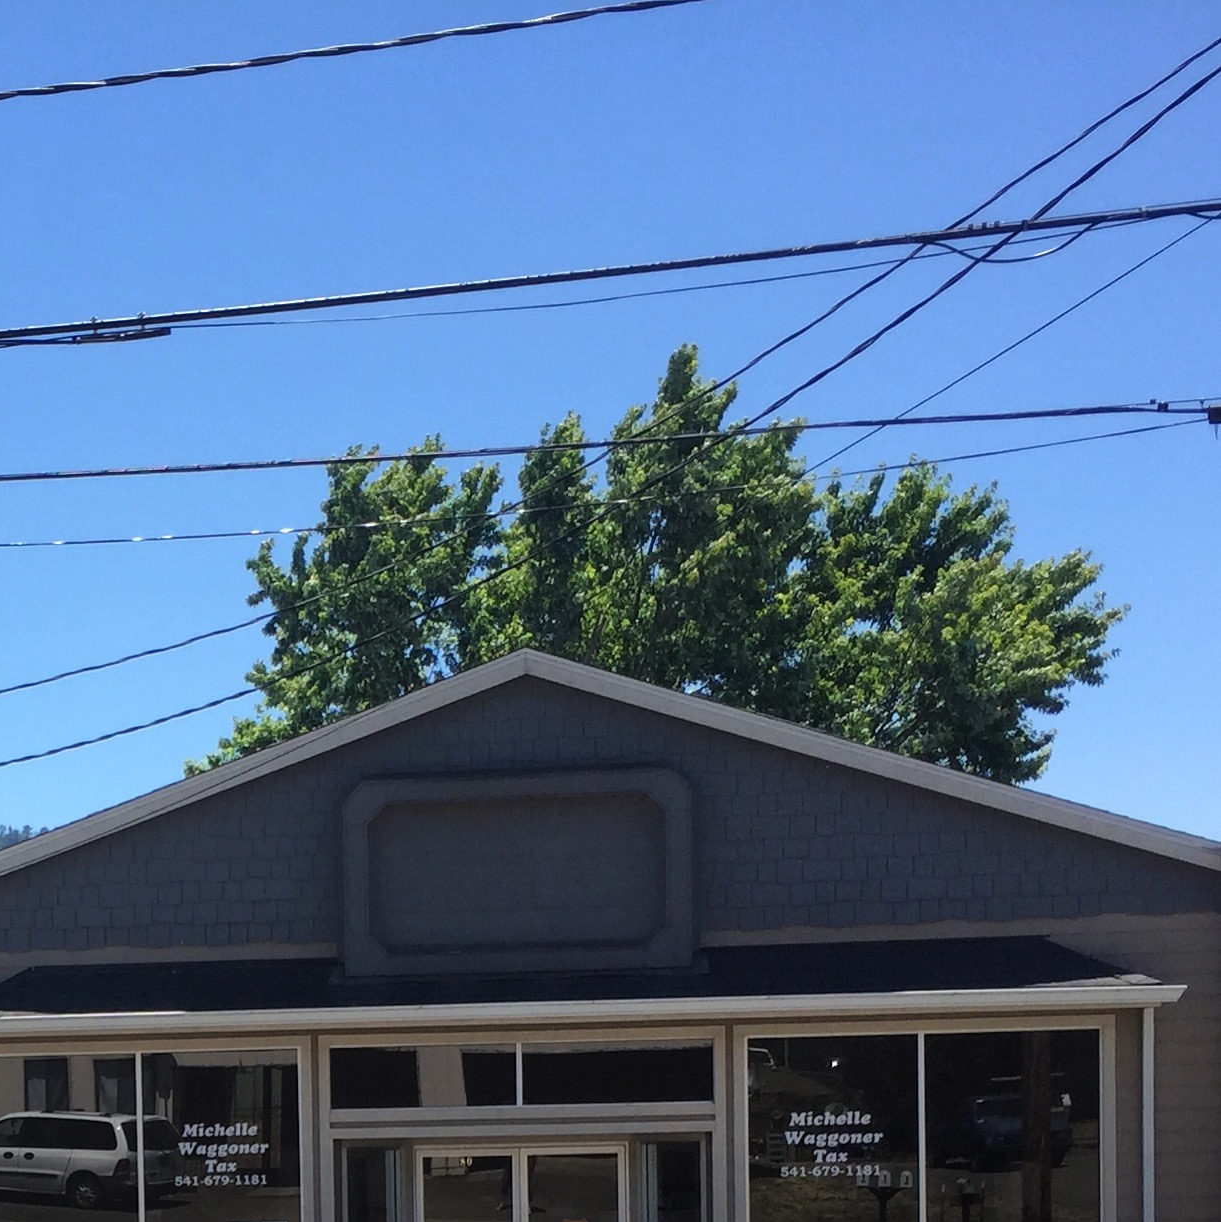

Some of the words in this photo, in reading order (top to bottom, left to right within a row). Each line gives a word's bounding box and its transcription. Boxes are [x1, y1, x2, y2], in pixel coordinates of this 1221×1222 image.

[789, 1111, 871, 1126] Michelle
[182, 1122, 258, 1138] Michelle
[784, 1131, 884, 1147] Waggoner
[178, 1141, 269, 1158] Waggoner
[813, 1149, 848, 1163] Tax
[204, 1159, 237, 1173] Tax
[780, 1165, 880, 1177] 541-679-1181
[174, 1174, 267, 1187] 541-679-1181
